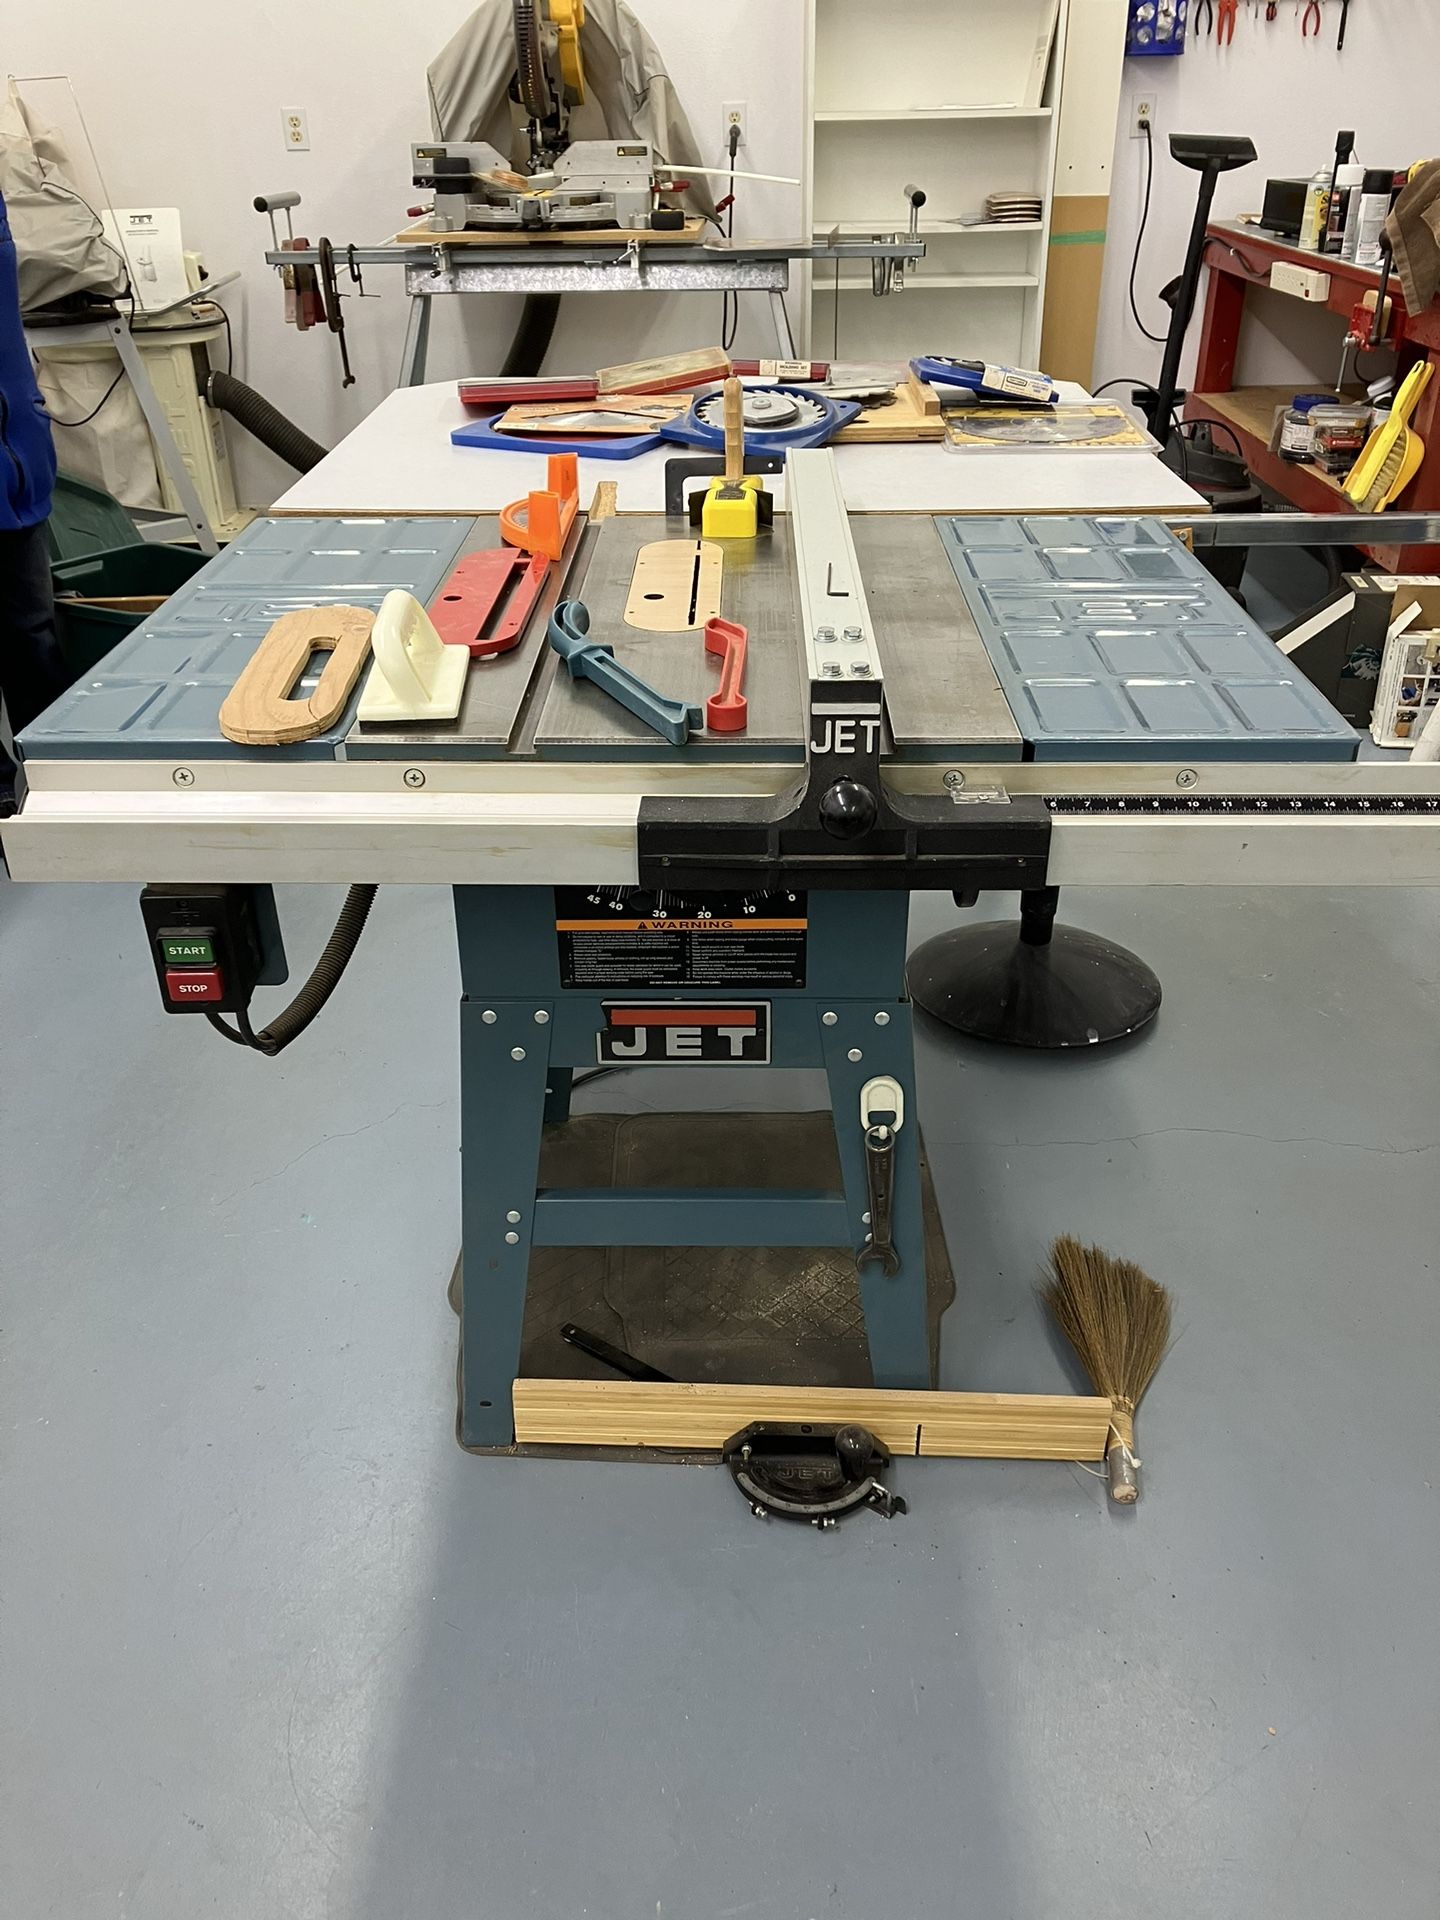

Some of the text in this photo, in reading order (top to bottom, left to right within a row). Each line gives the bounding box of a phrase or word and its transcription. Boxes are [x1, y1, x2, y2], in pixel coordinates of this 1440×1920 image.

[810, 720, 880, 753] JET
[586, 893, 796, 919] 45 40 30 20 10 0
[651, 920, 734, 929] WARNING
[168, 946, 206, 955] START
[178, 984, 208, 993] STOP
[611, 1027, 757, 1056] JET
